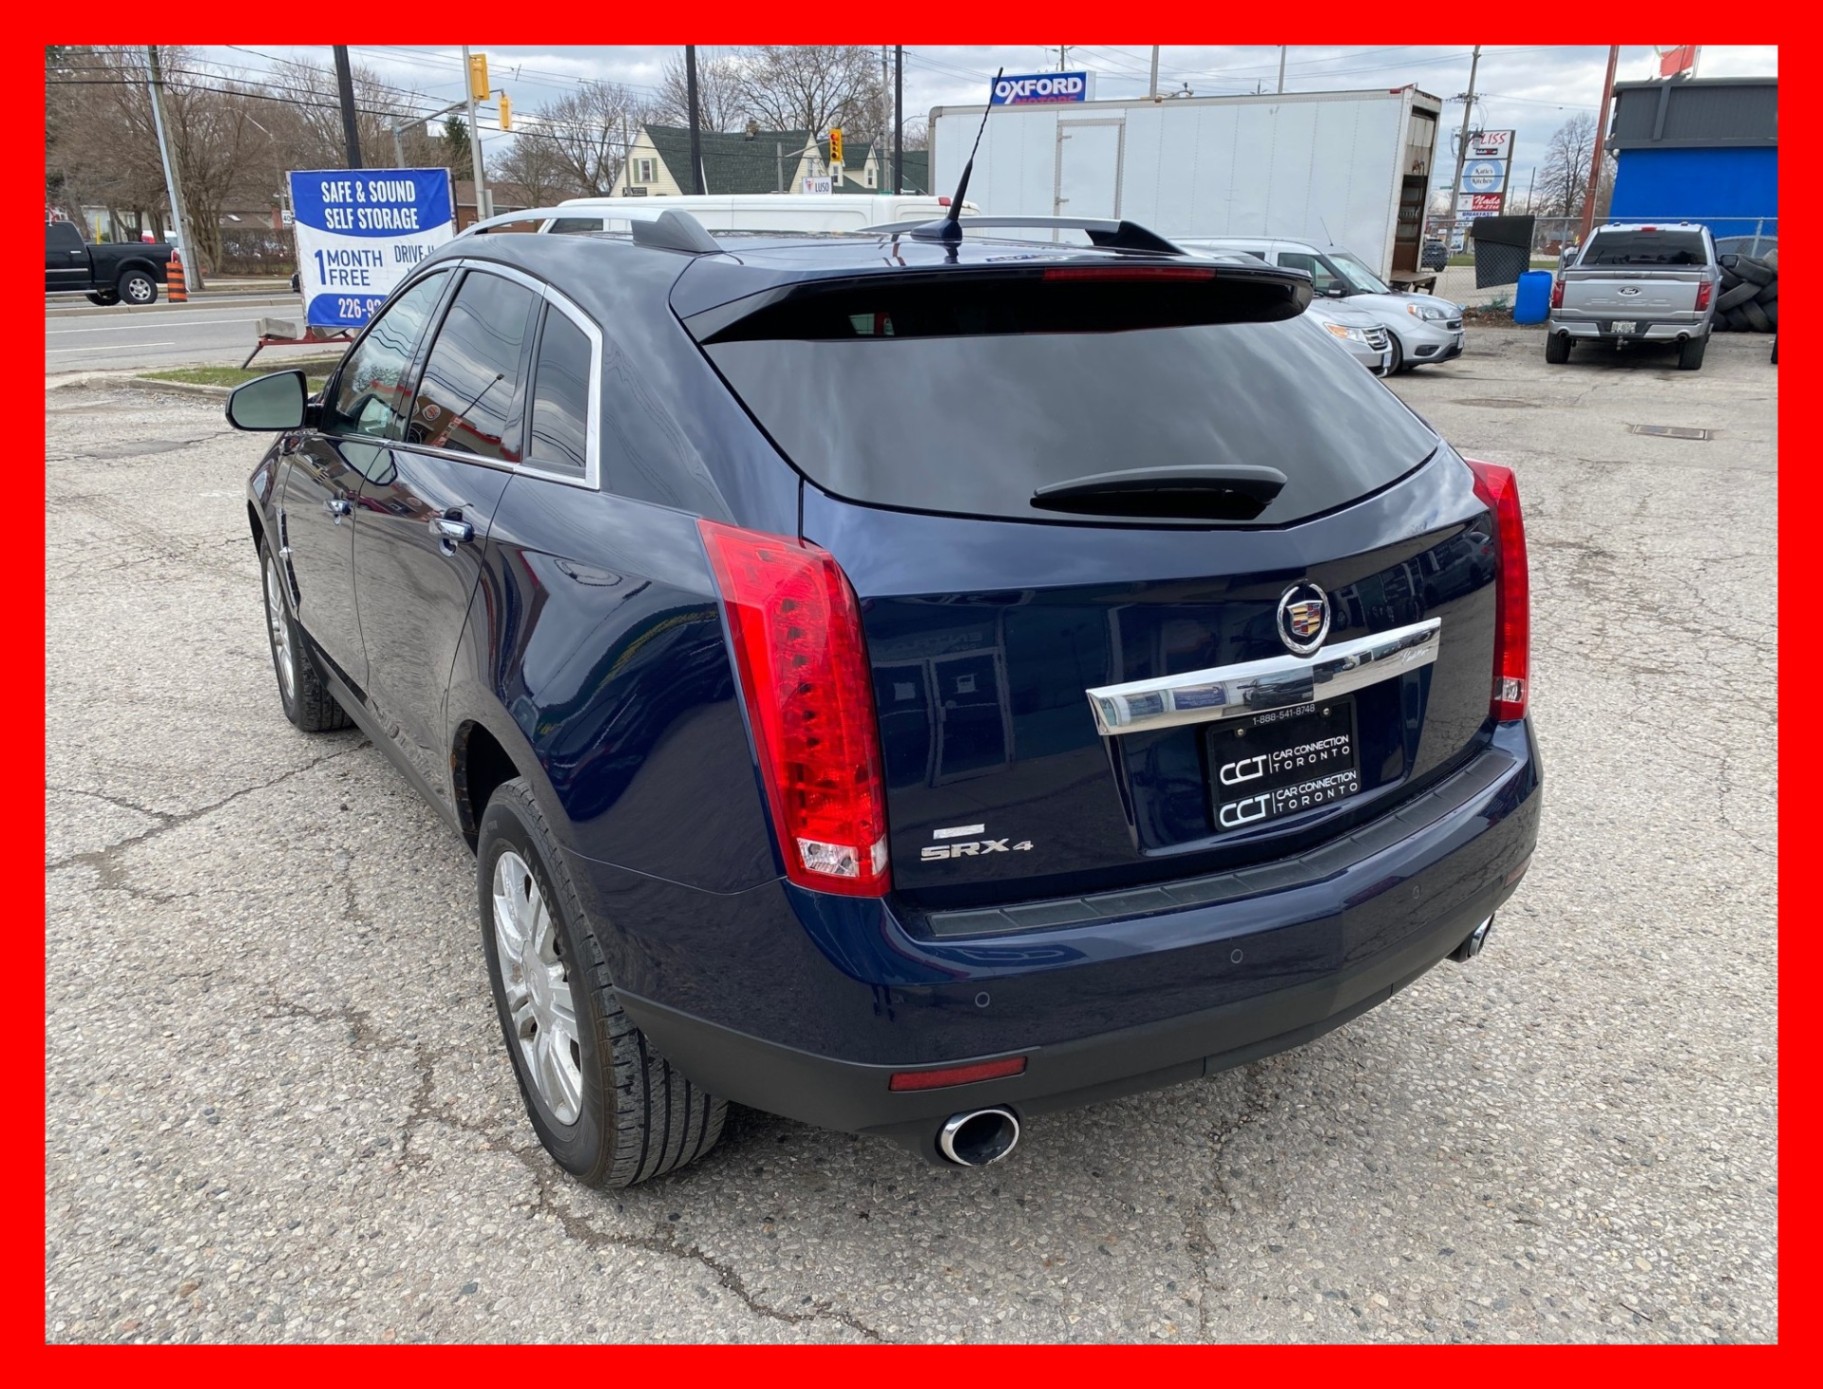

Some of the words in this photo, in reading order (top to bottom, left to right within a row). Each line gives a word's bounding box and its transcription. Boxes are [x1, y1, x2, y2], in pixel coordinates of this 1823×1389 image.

[995, 77, 1082, 104] OXFORD
[321, 181, 353, 203] SAFE
[356, 181, 366, 203] &
[369, 180, 415, 203] SOUND
[324, 208, 354, 230] SELF
[357, 208, 420, 229] STORAGE
[314, 249, 326, 286] 1
[327, 249, 383, 267] MONTH
[329, 269, 371, 287] FREE
[1252, 703, 1316, 726] 1-888-541-8748
[1272, 748, 1293, 761] CAR
[1293, 734, 1349, 756] CONNECTION
[1273, 745, 1350, 773] TORONTO
[1276, 787, 1298, 800] CAR
[1298, 770, 1357, 794] CONNECTION
[1277, 782, 1358, 813] TORONTO
[921, 838, 1009, 861] SRX
